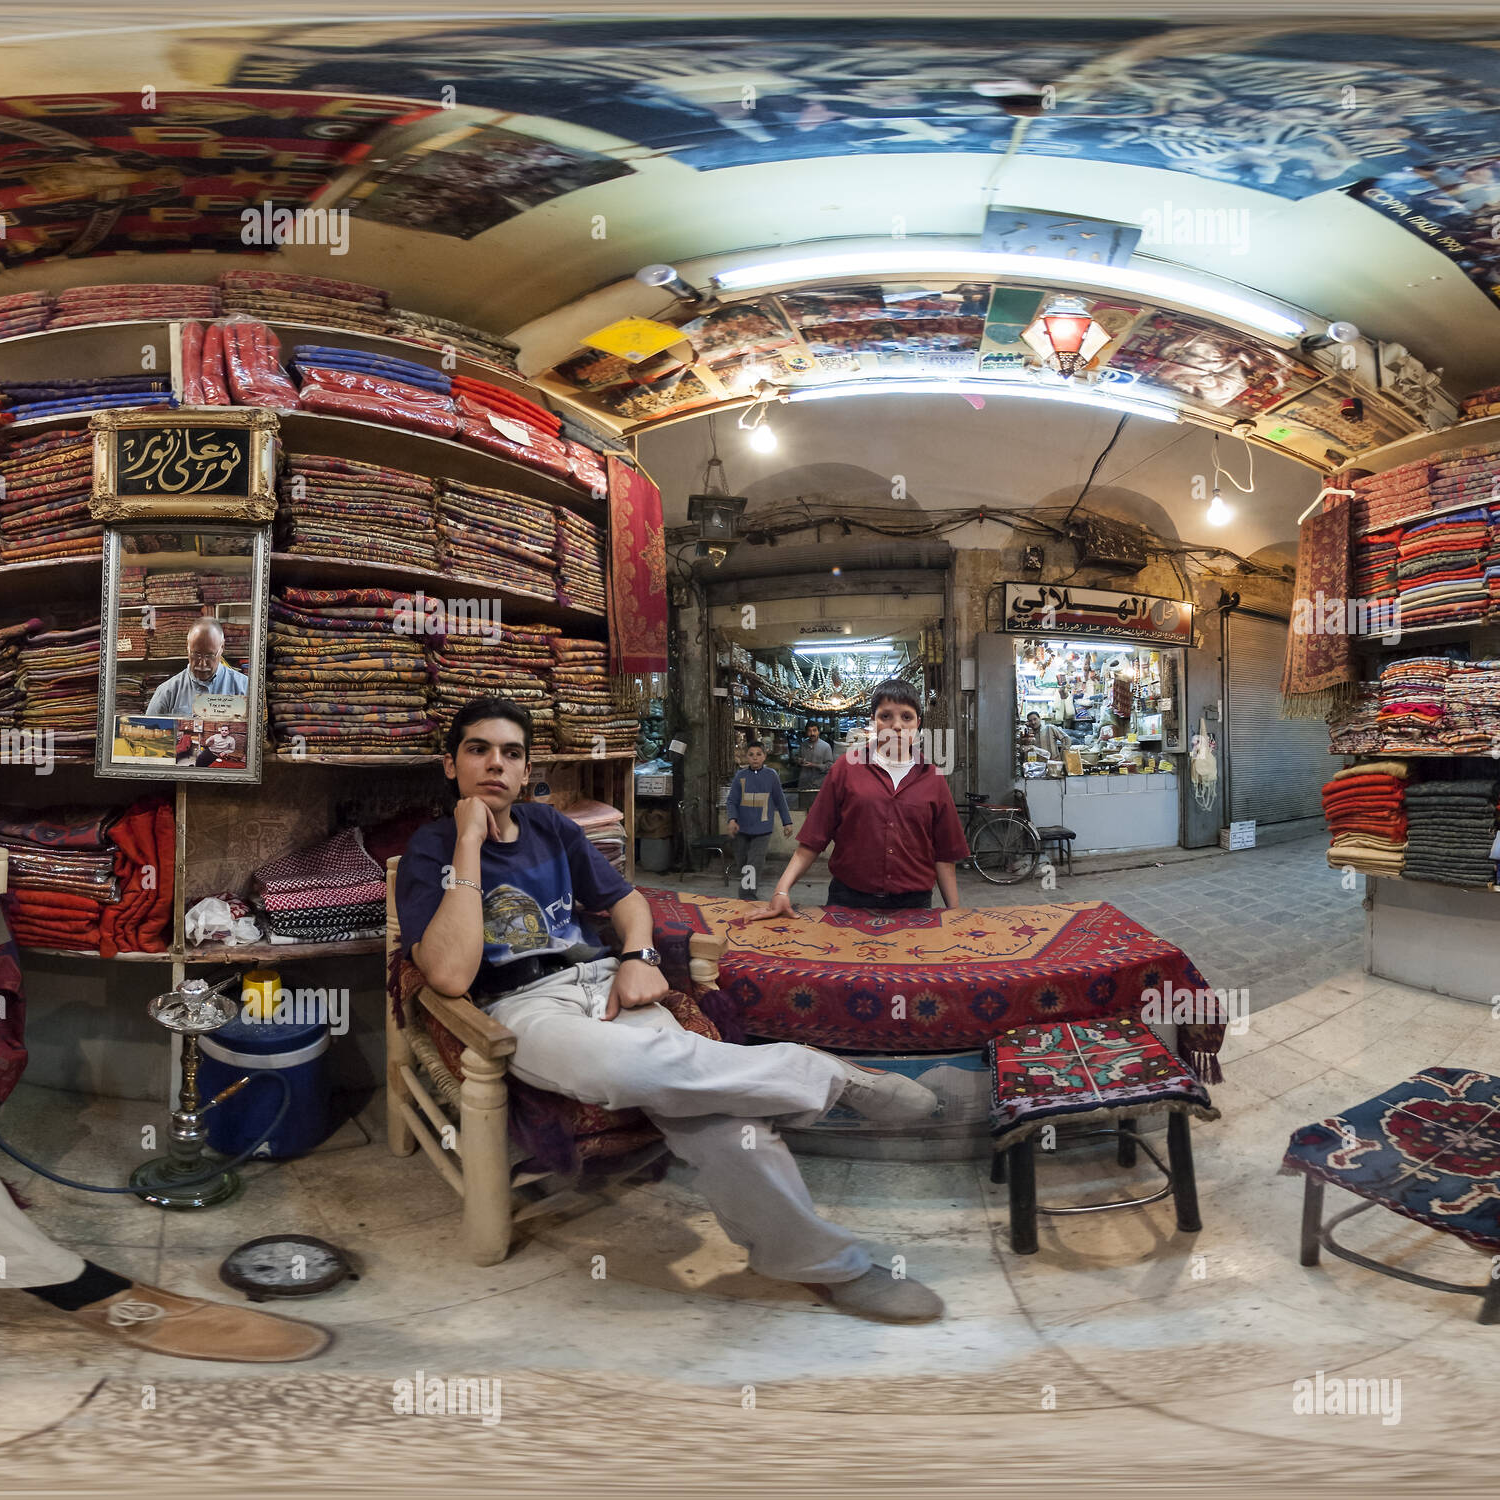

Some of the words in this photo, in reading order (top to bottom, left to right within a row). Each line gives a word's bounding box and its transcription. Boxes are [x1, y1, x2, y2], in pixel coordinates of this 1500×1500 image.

[1362, 187, 1413, 217] COPPA
[1405, 215, 1442, 237] ITALIA
[1011, 586, 1147, 621] الهلالي
